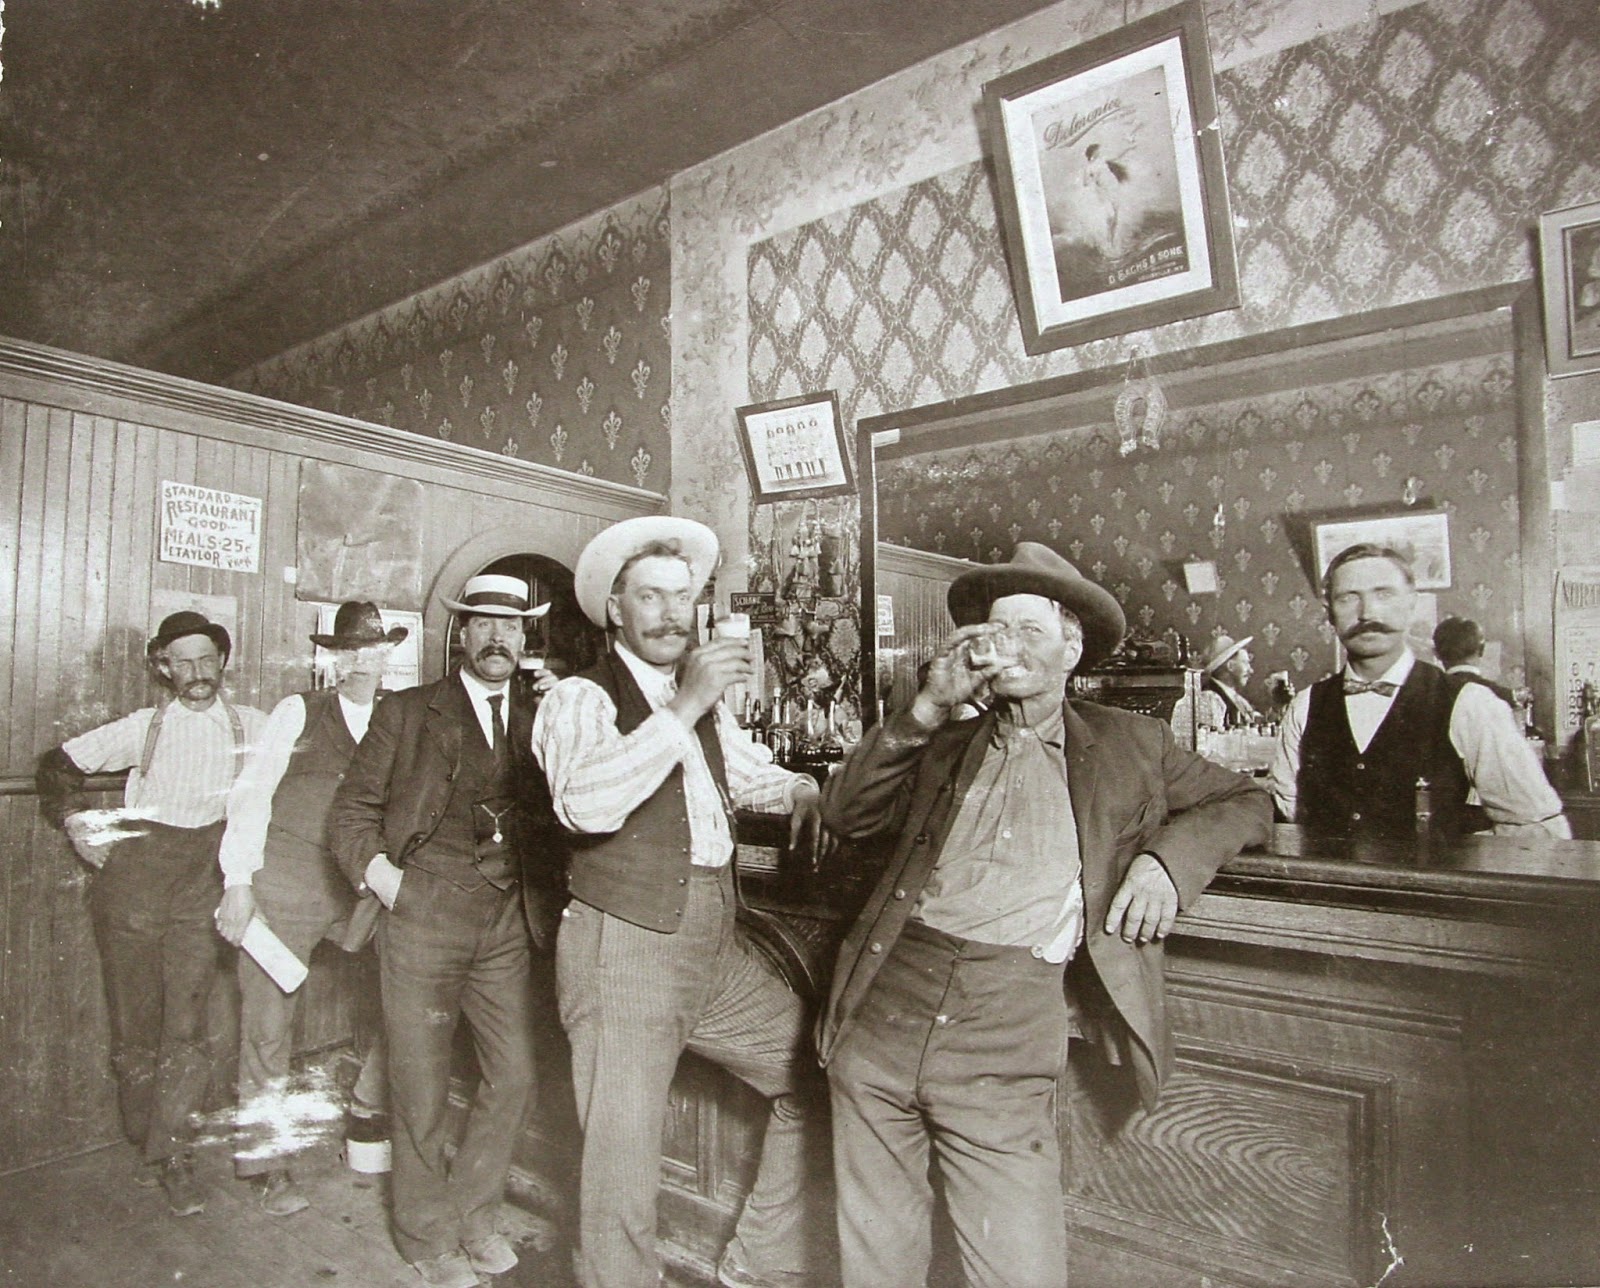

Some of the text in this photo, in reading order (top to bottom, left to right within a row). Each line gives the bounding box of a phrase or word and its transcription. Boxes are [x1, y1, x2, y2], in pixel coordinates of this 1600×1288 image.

[165, 486, 232, 504] STANDARD
[166, 500, 256, 535] RESTAURANT
[187, 516, 228, 531] GOOD
[164, 527, 217, 551] MEALS
[1588, 661, 1595, 677] 7
